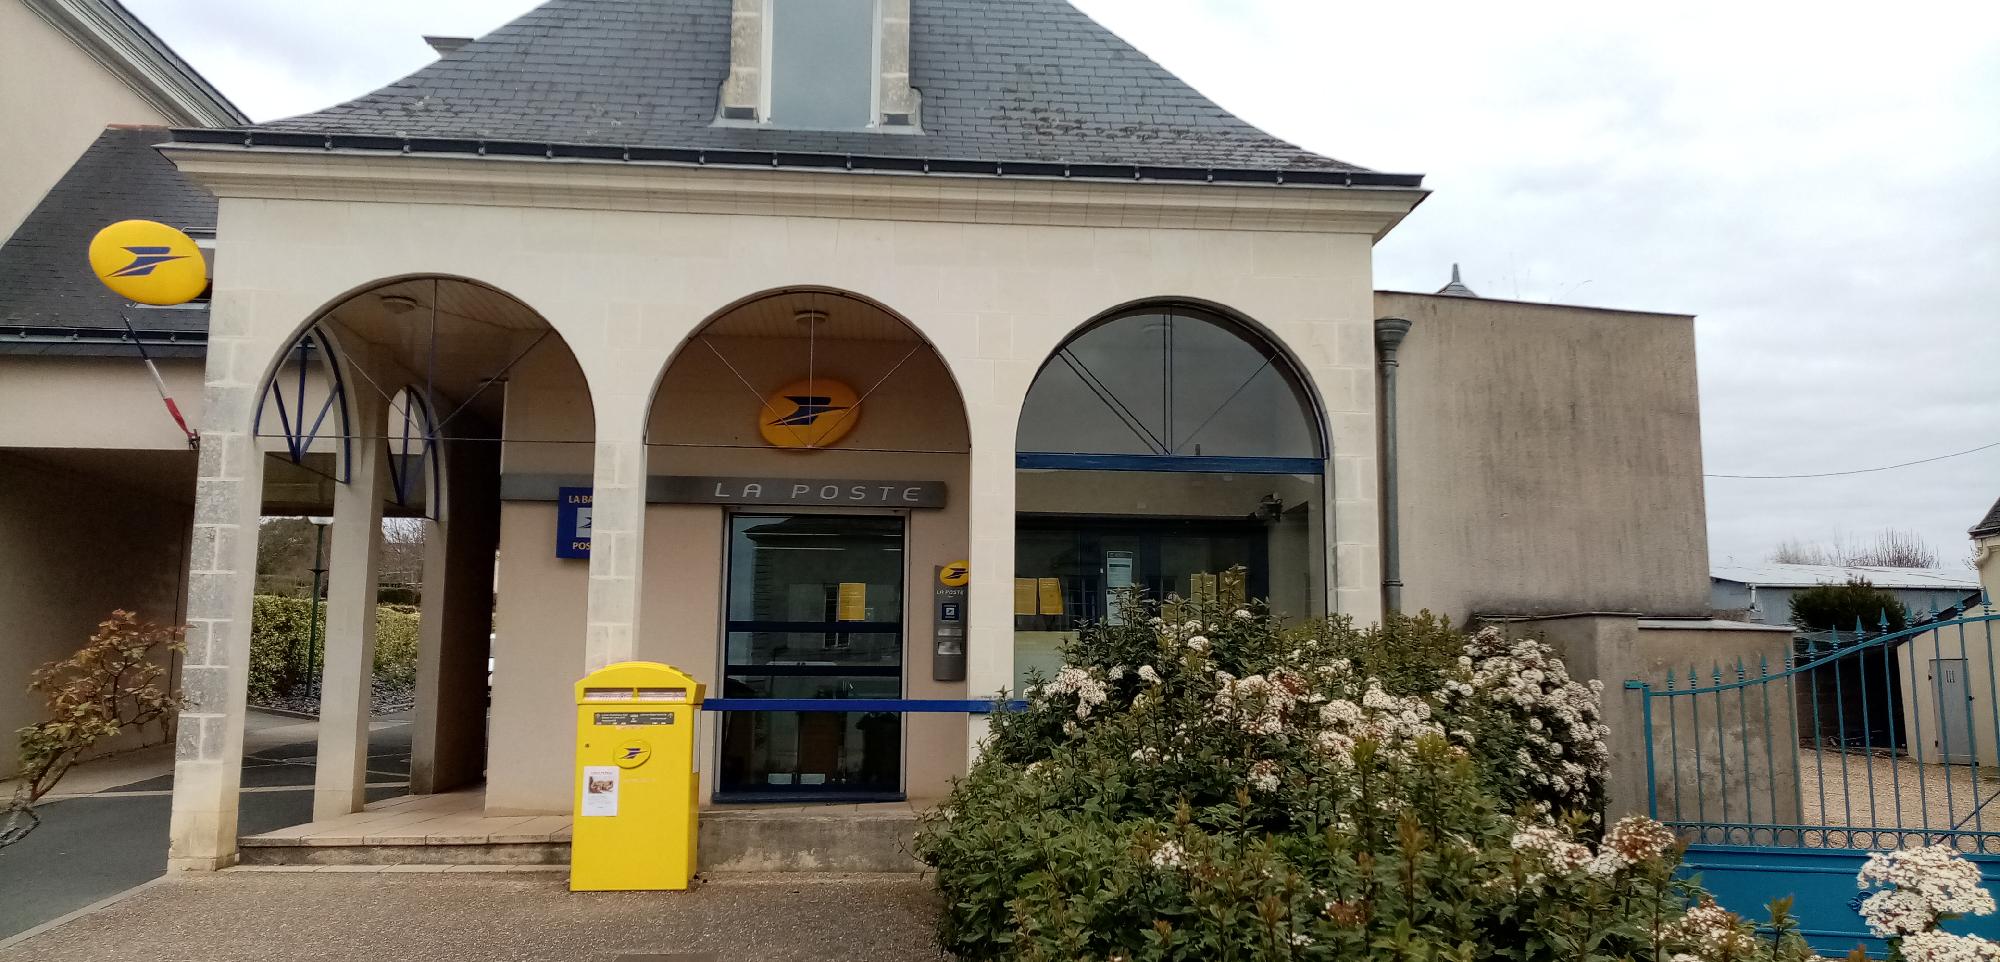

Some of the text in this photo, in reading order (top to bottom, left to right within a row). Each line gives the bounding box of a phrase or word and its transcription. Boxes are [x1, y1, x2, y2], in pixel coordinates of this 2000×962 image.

[714, 482, 921, 502] LA POSTE
[568, 496, 580, 504] LA
